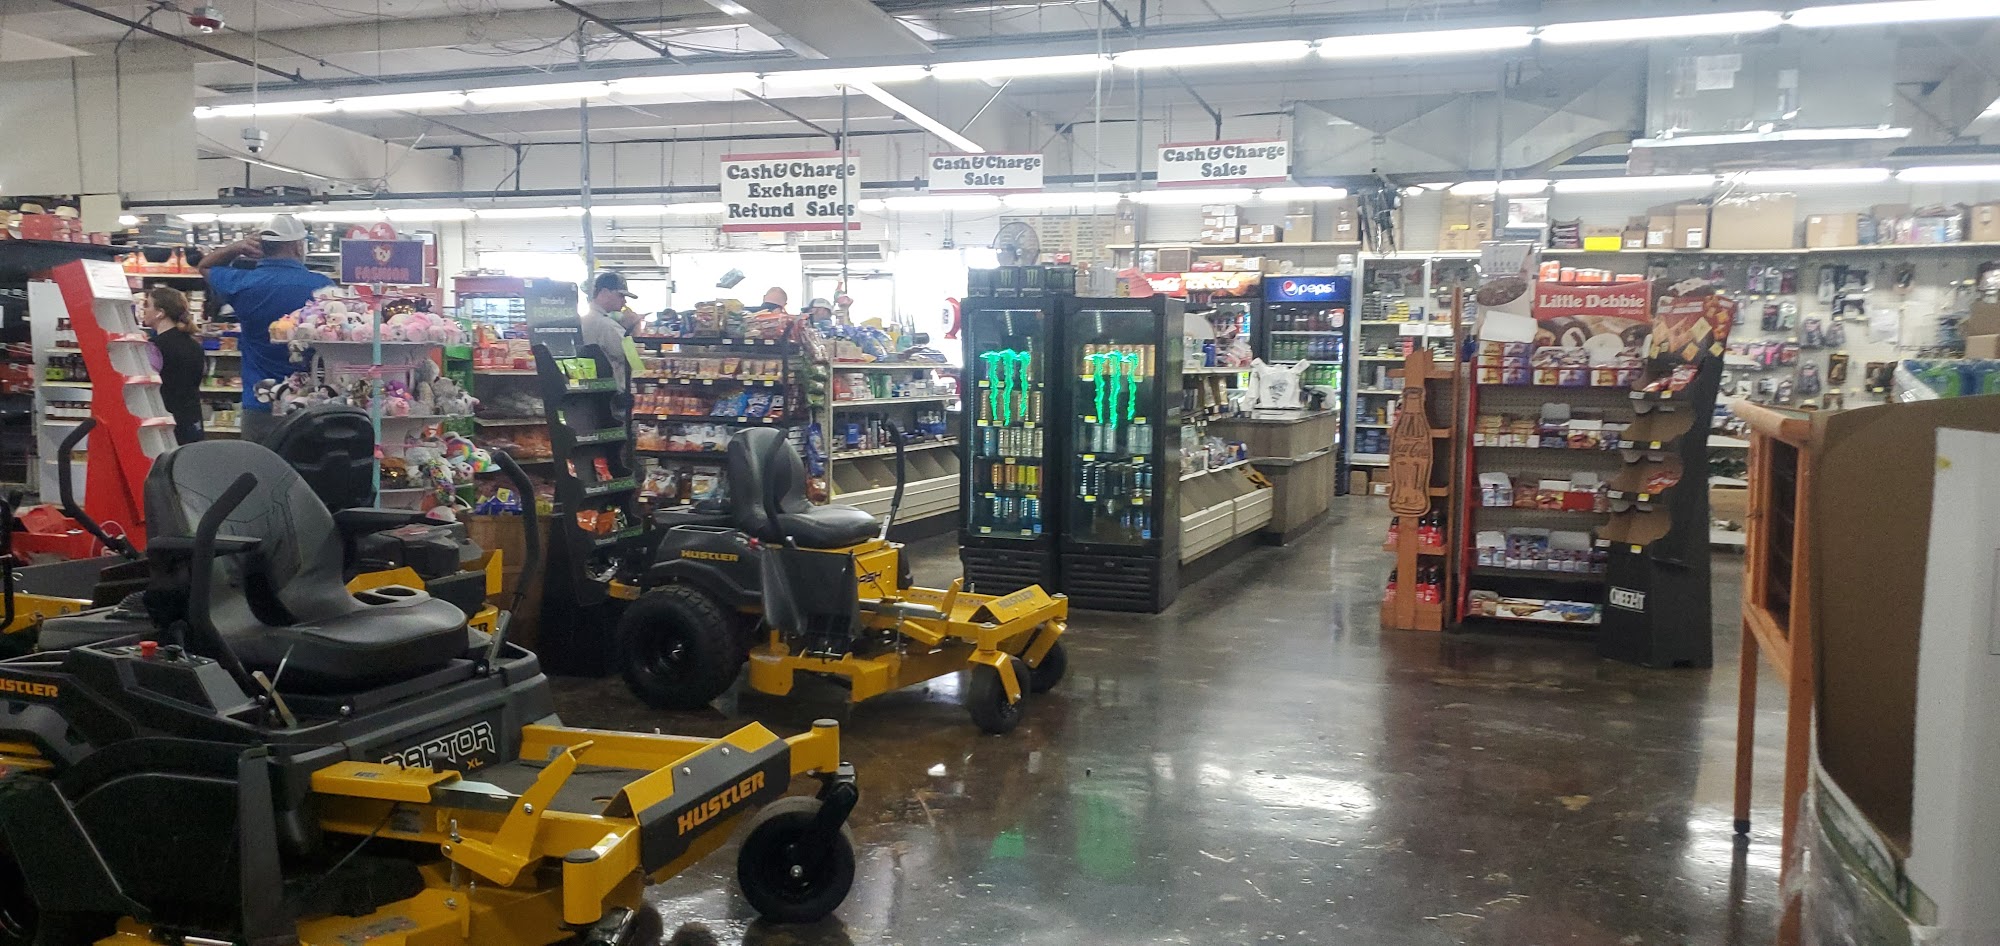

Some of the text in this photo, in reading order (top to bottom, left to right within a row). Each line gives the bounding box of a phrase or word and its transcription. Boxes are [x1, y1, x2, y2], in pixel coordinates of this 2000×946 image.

[1163, 145, 1286, 162] Cash&Charge
[727, 162, 856, 180] Cash&Charge
[932, 156, 1041, 171] Cash&Charge
[1201, 162, 1248, 178] Sales
[964, 172, 1005, 186] Sales
[748, 182, 838, 199] Exchange
[728, 201, 855, 218] Refund Sales
[1298, 281, 1337, 295] pepsi
[1539, 294, 1583, 308] Little
[1585, 294, 1645, 308] Debbie
[681, 549, 739, 562] HUSTLER
[0, 677, 59, 698] STLER
[467, 757, 484, 771] XL
[677, 770, 765, 836] HUSTLER
